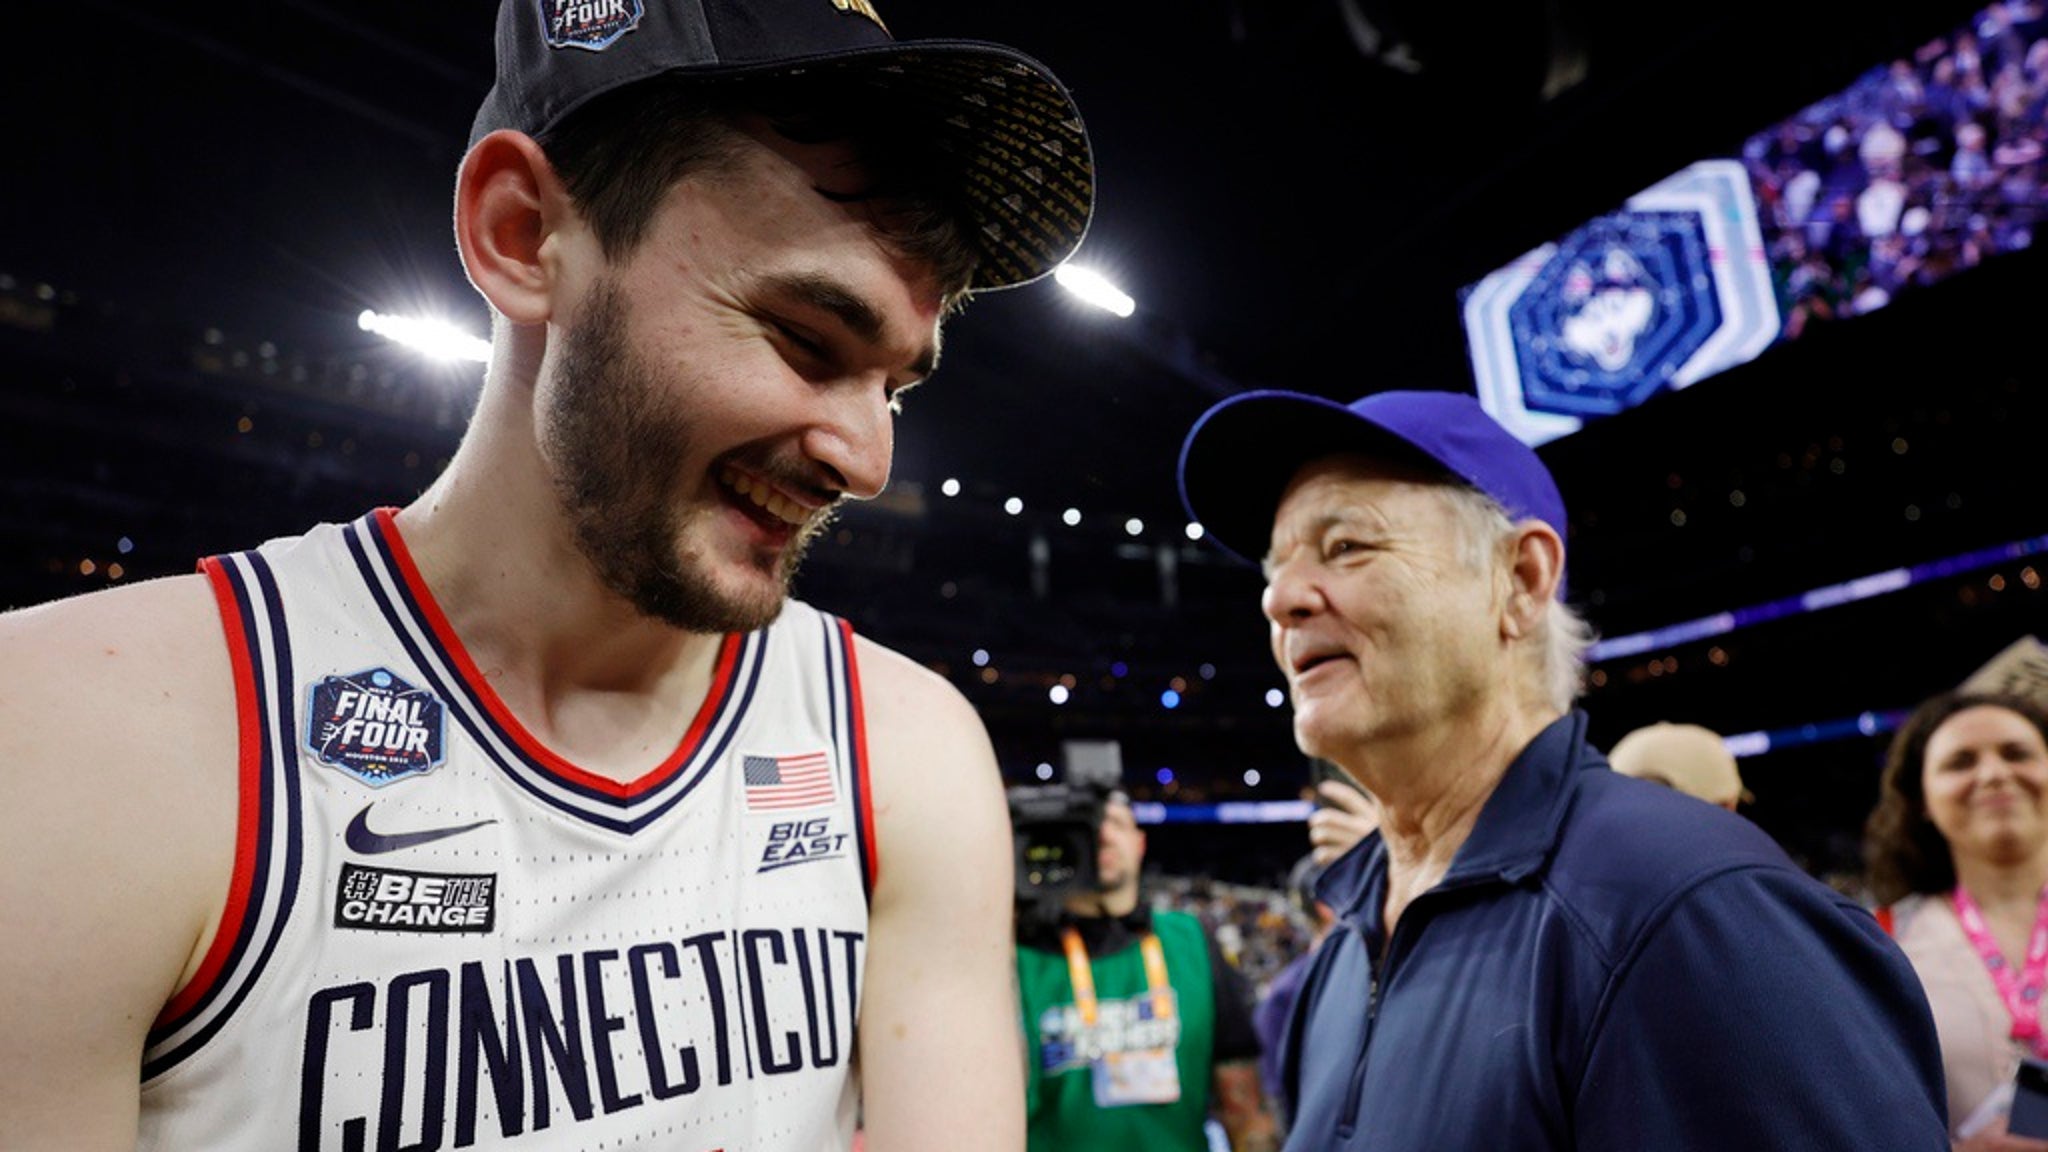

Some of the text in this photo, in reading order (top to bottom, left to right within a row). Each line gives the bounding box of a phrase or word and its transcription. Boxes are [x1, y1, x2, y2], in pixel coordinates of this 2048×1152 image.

[566, 0, 624, 27] FOUR
[335, 690, 423, 726] FINAL
[341, 720, 429, 752] FOUR
[768, 817, 830, 842] BIG
[761, 834, 848, 862] EAST
[341, 901, 489, 926] CHANGE
[299, 928, 864, 1152] CONNECTICUT
